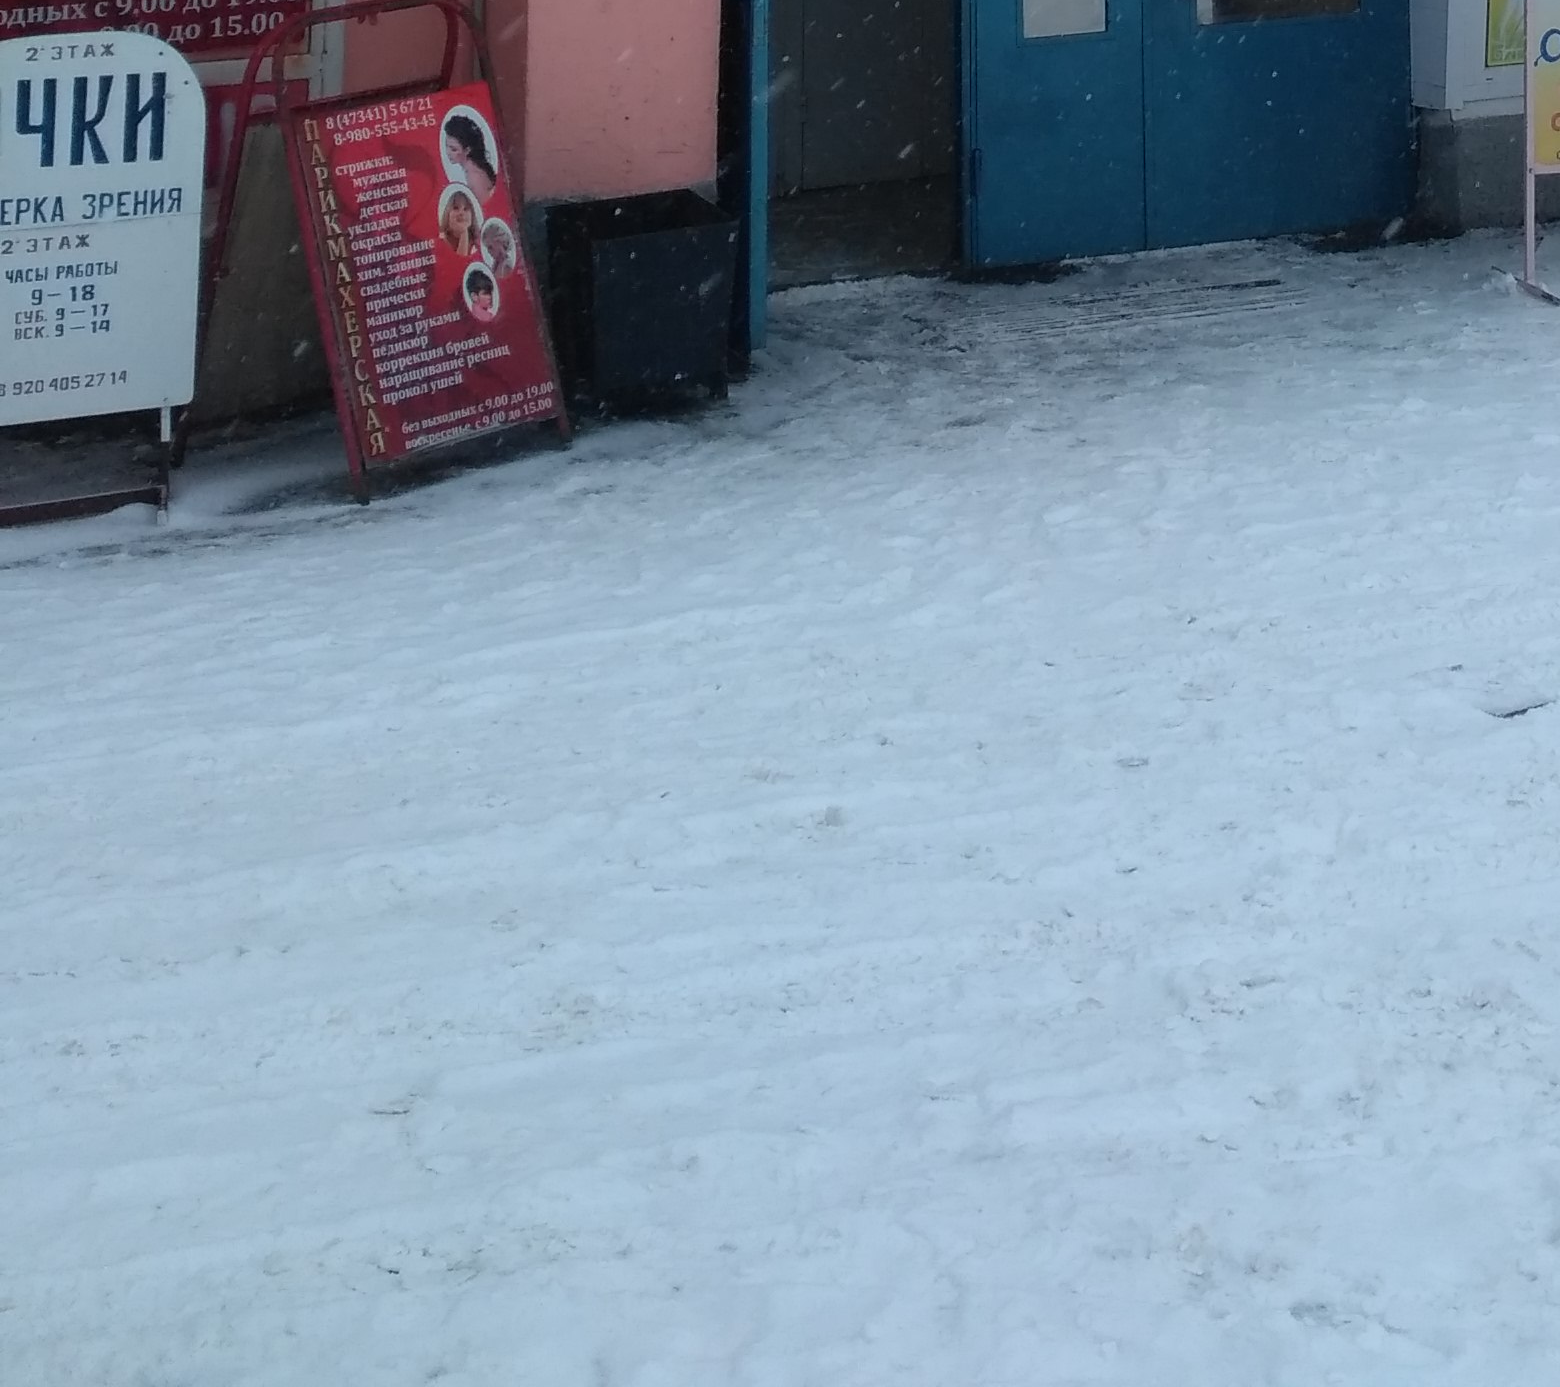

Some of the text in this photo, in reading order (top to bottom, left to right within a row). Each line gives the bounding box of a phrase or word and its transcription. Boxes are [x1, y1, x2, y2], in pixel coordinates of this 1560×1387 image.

[94, 1, 108, 17] с
[166, 23, 201, 44] до
[51, 43, 115, 60] ЭТАЖ
[82, 187, 182, 220] ЗРЕНИЯ
[360, 199, 409, 220] детская
[26, 234, 90, 253] ЭТАЖ
[5, 261, 118, 283] ЧАСЫ РАБОТЫ
[13, 380, 44, 395] 920
[49, 376, 80, 391] 405
